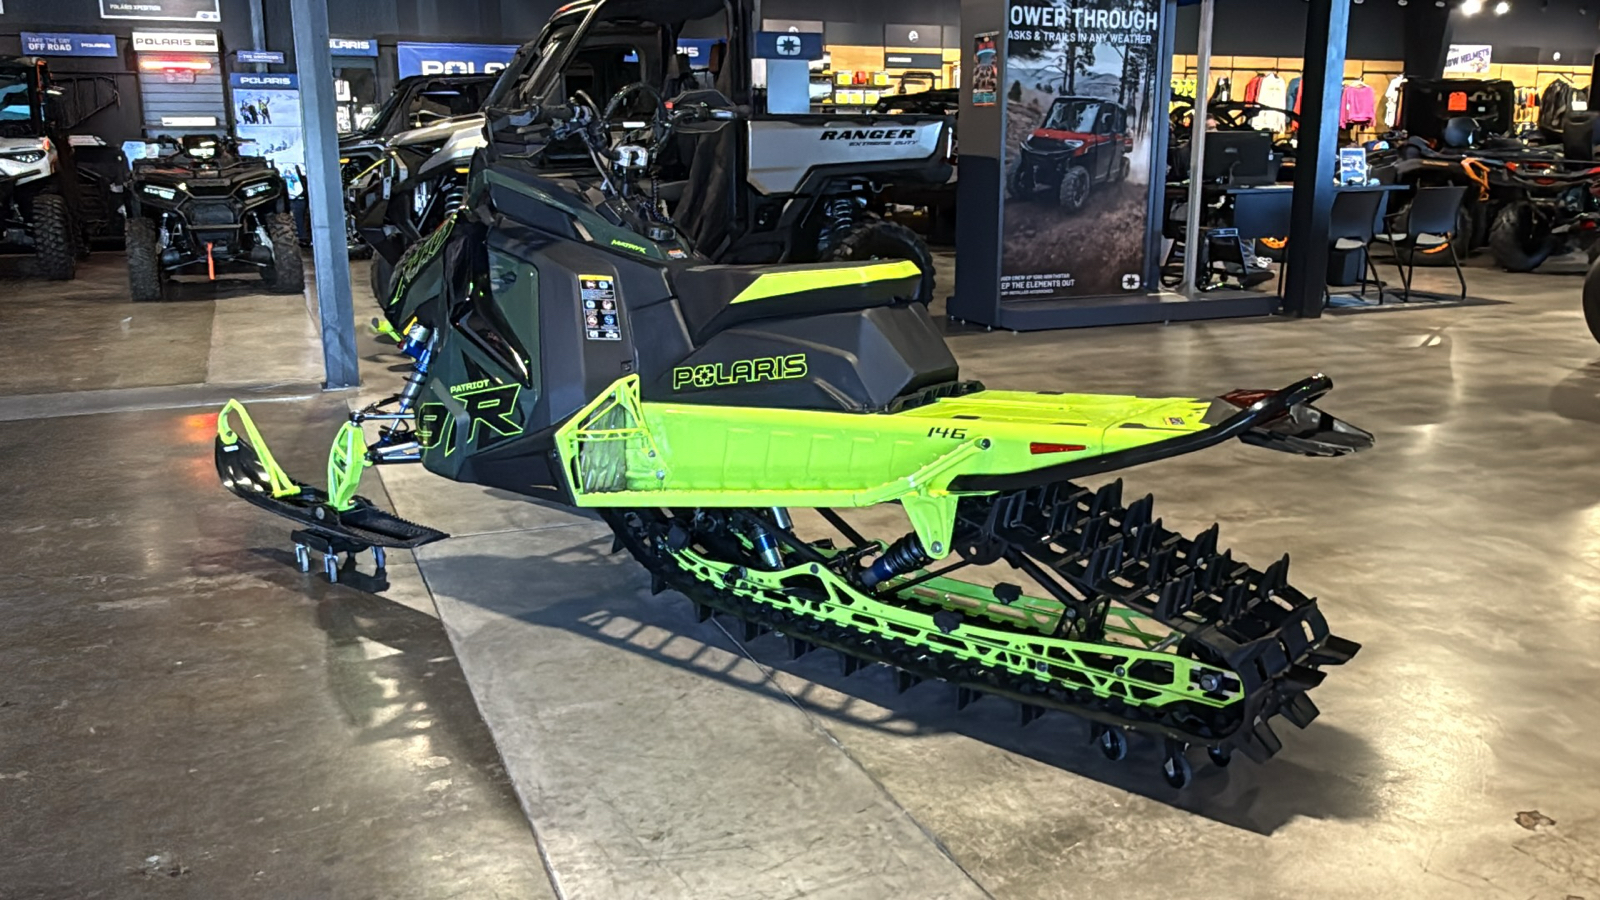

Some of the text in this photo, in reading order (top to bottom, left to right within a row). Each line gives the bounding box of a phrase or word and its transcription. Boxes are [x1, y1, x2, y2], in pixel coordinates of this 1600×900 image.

[1071, 8, 1157, 31] THROUGH
[136, 38, 191, 46] POLARIS
[1034, 31, 1040, 41] &
[1044, 31, 1076, 42] TRAILS
[1078, 33, 1087, 43] IN
[1089, 33, 1107, 43] ANY
[1110, 34, 1152, 44] WEATHER
[28, 43, 72, 51] OFF ROAD
[329, 39, 370, 50] LARIS
[1460, 48, 1490, 63] HELMETS
[240, 76, 291, 85] POLARIS
[820, 129, 916, 141] RANGER
[1012, 281, 1025, 289] THE
[1026, 280, 1061, 289] ELEMENTS
[1061, 279, 1076, 287] OUT
[673, 353, 808, 390] POLARIS
[450, 379, 490, 394] PATRIOT
[927, 426, 968, 440] 146
